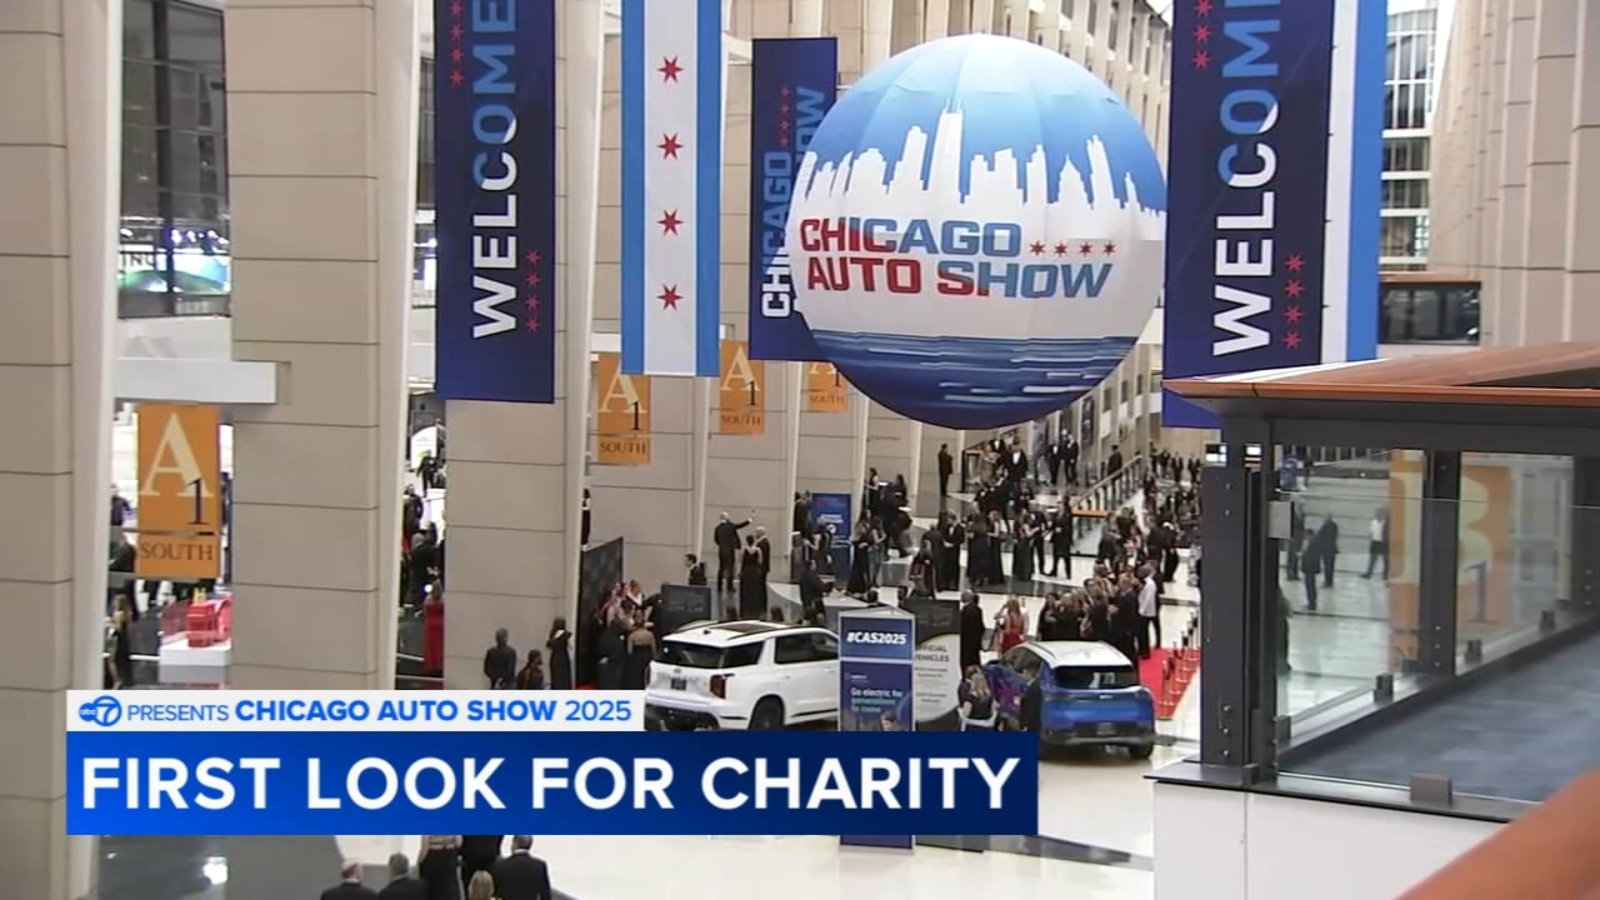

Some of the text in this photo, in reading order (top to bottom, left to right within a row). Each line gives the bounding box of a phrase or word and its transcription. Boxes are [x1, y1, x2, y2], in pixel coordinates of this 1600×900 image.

[473, 0, 517, 338] WELCOME
[1213, 0, 1281, 356] WELCOM
[762, 152, 793, 318] CHICAGO
[800, 217, 1022, 257] CHICAGO
[807, 257, 1113, 299] AUTO SHOW
[720, 414, 761, 426] SOUTH
[600, 441, 646, 454] SOUTH
[140, 543, 214, 561] SOUTH
[846, 631, 907, 645] #CAS2025
